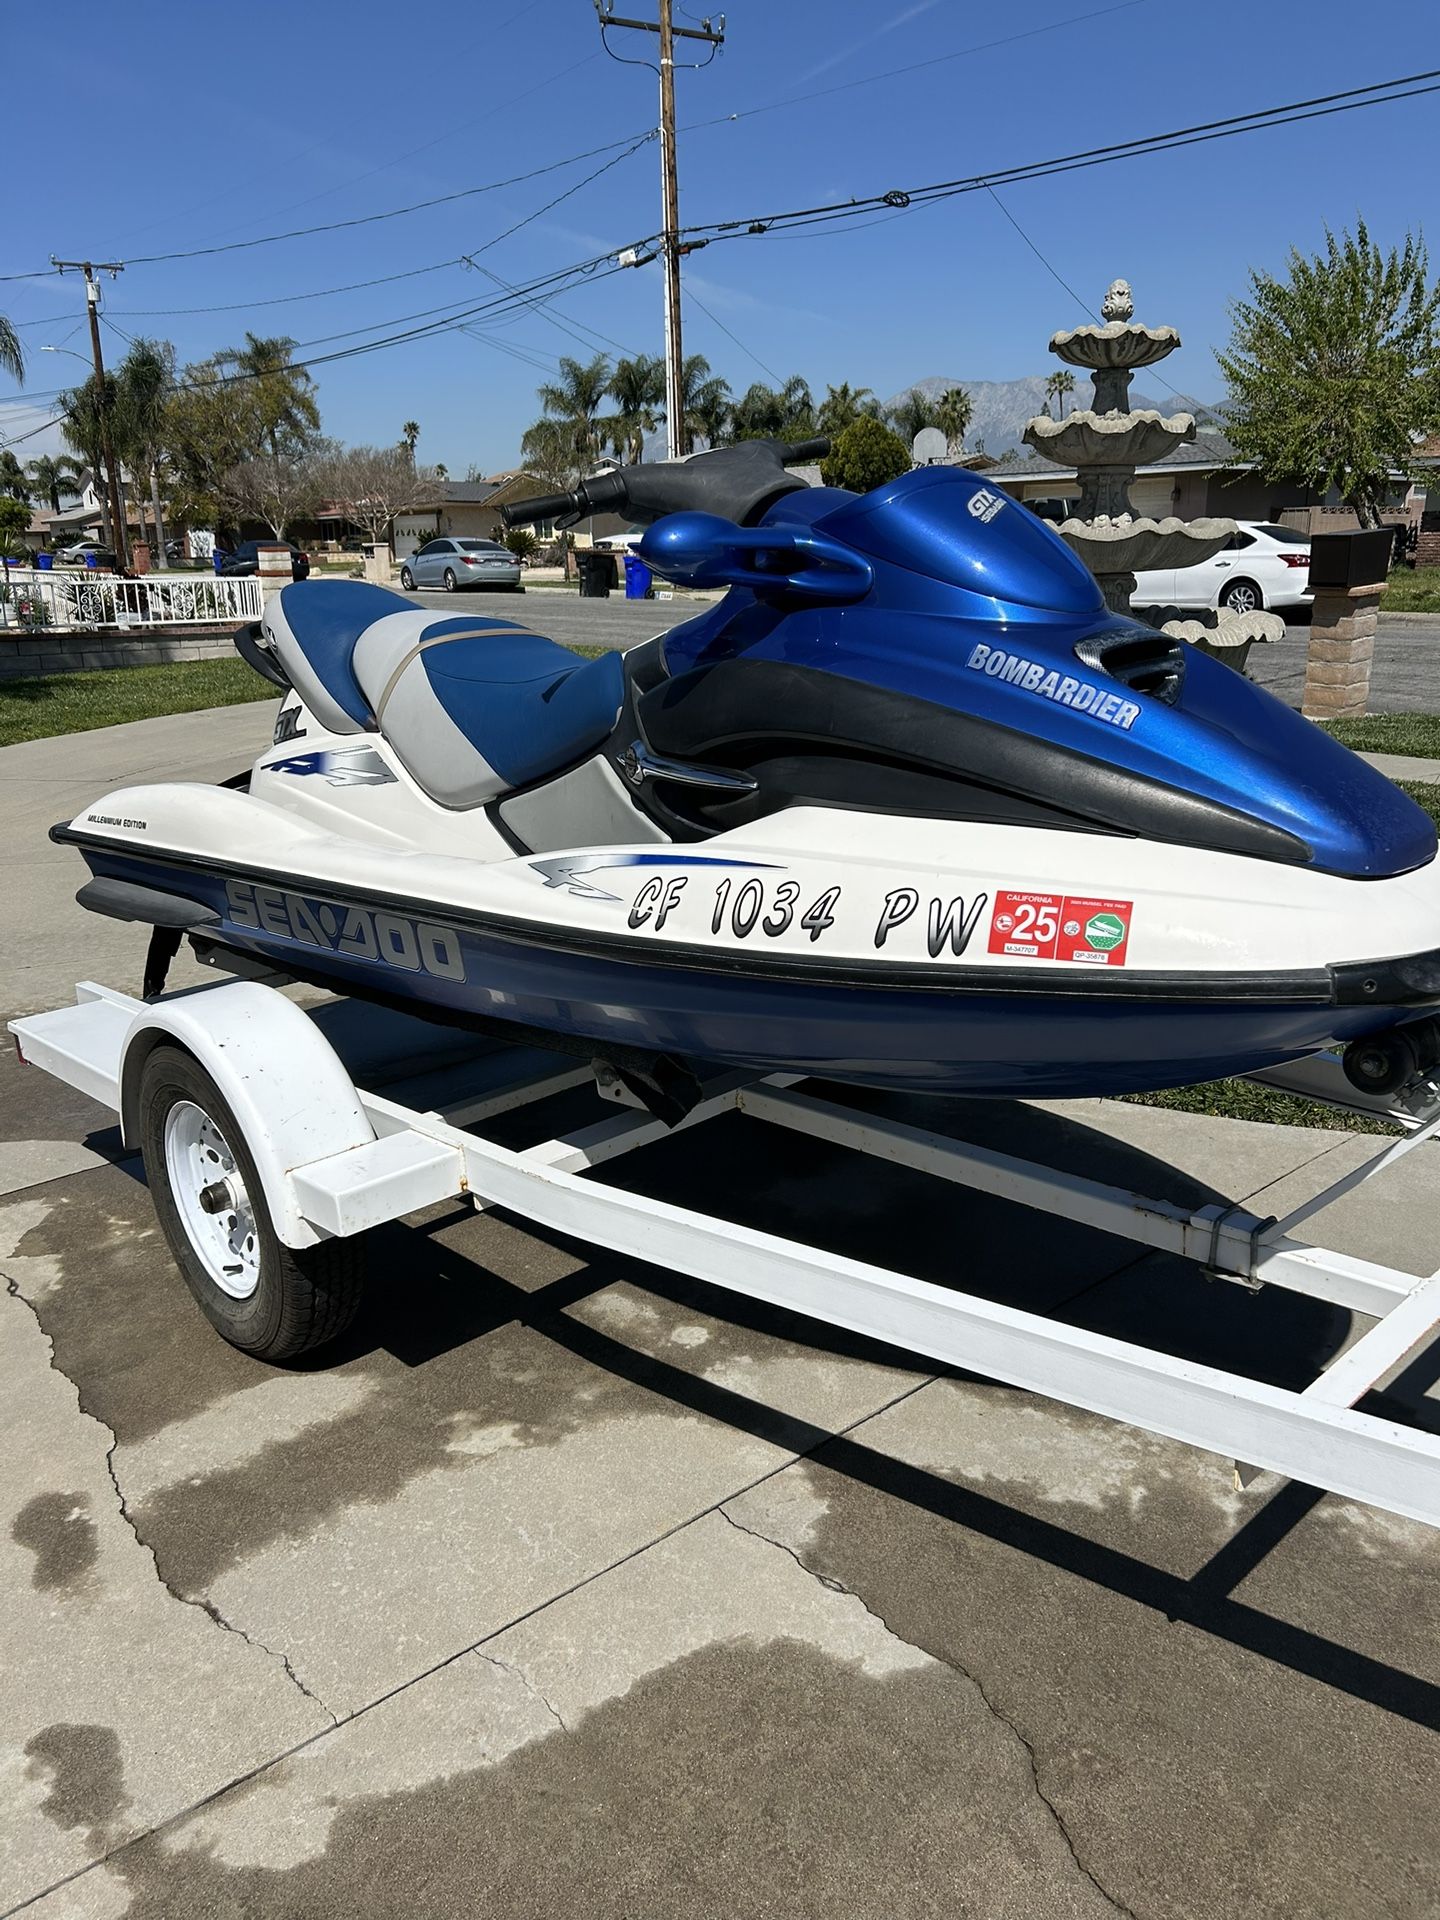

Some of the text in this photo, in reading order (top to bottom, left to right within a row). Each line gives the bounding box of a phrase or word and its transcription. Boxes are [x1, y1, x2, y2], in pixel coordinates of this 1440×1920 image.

[967, 487, 997, 517] GTX
[966, 642, 1141, 731] BOMBARDIER
[122, 818, 147, 830] EDITION
[627, 876, 688, 932] CF
[711, 878, 841, 943] 1034
[1006, 893, 1053, 904] CALIFORNIA
[1010, 904, 1060, 942] 25
